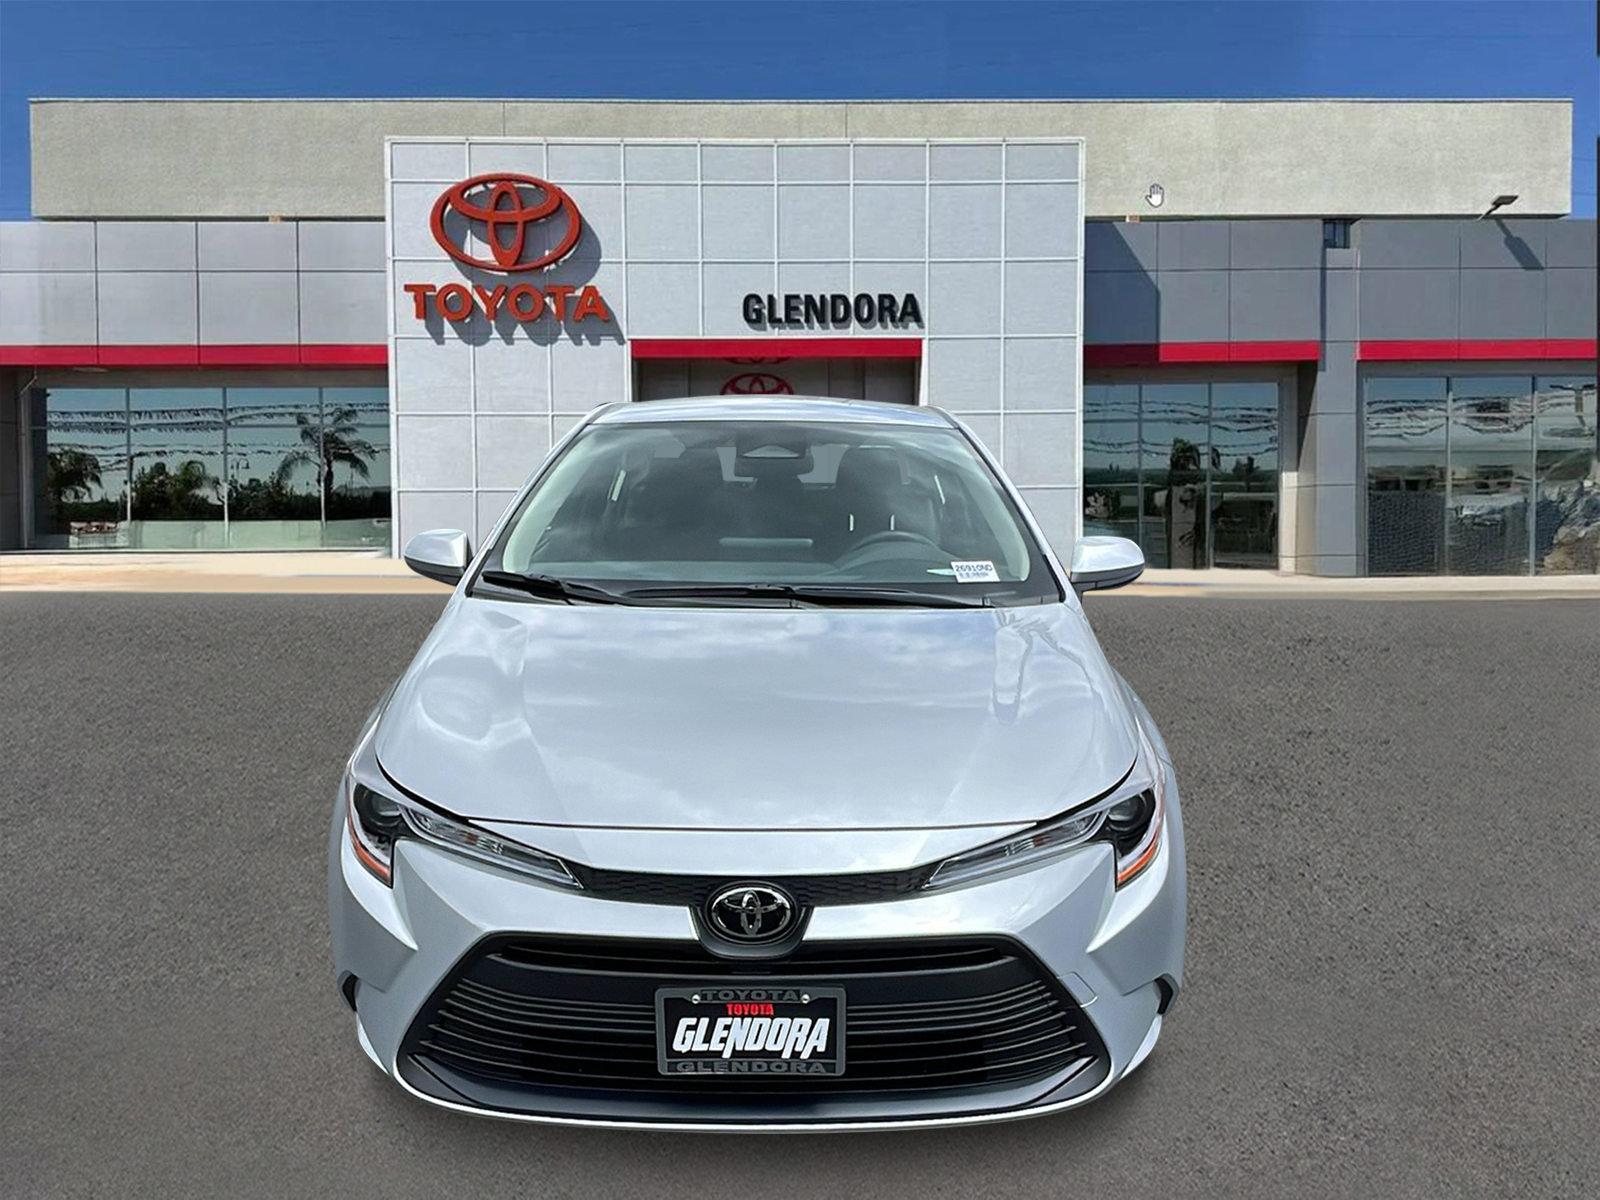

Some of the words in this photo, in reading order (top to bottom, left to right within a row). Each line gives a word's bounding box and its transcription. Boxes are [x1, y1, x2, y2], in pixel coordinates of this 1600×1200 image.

[404, 283, 610, 322] TOYOTA
[743, 293, 923, 325] GLENDORA
[702, 990, 798, 1000] TOYOTA
[726, 1003, 774, 1016] TOYOTA
[672, 1017, 830, 1059] GLENDORA
[676, 1061, 826, 1073] GLENDORA
